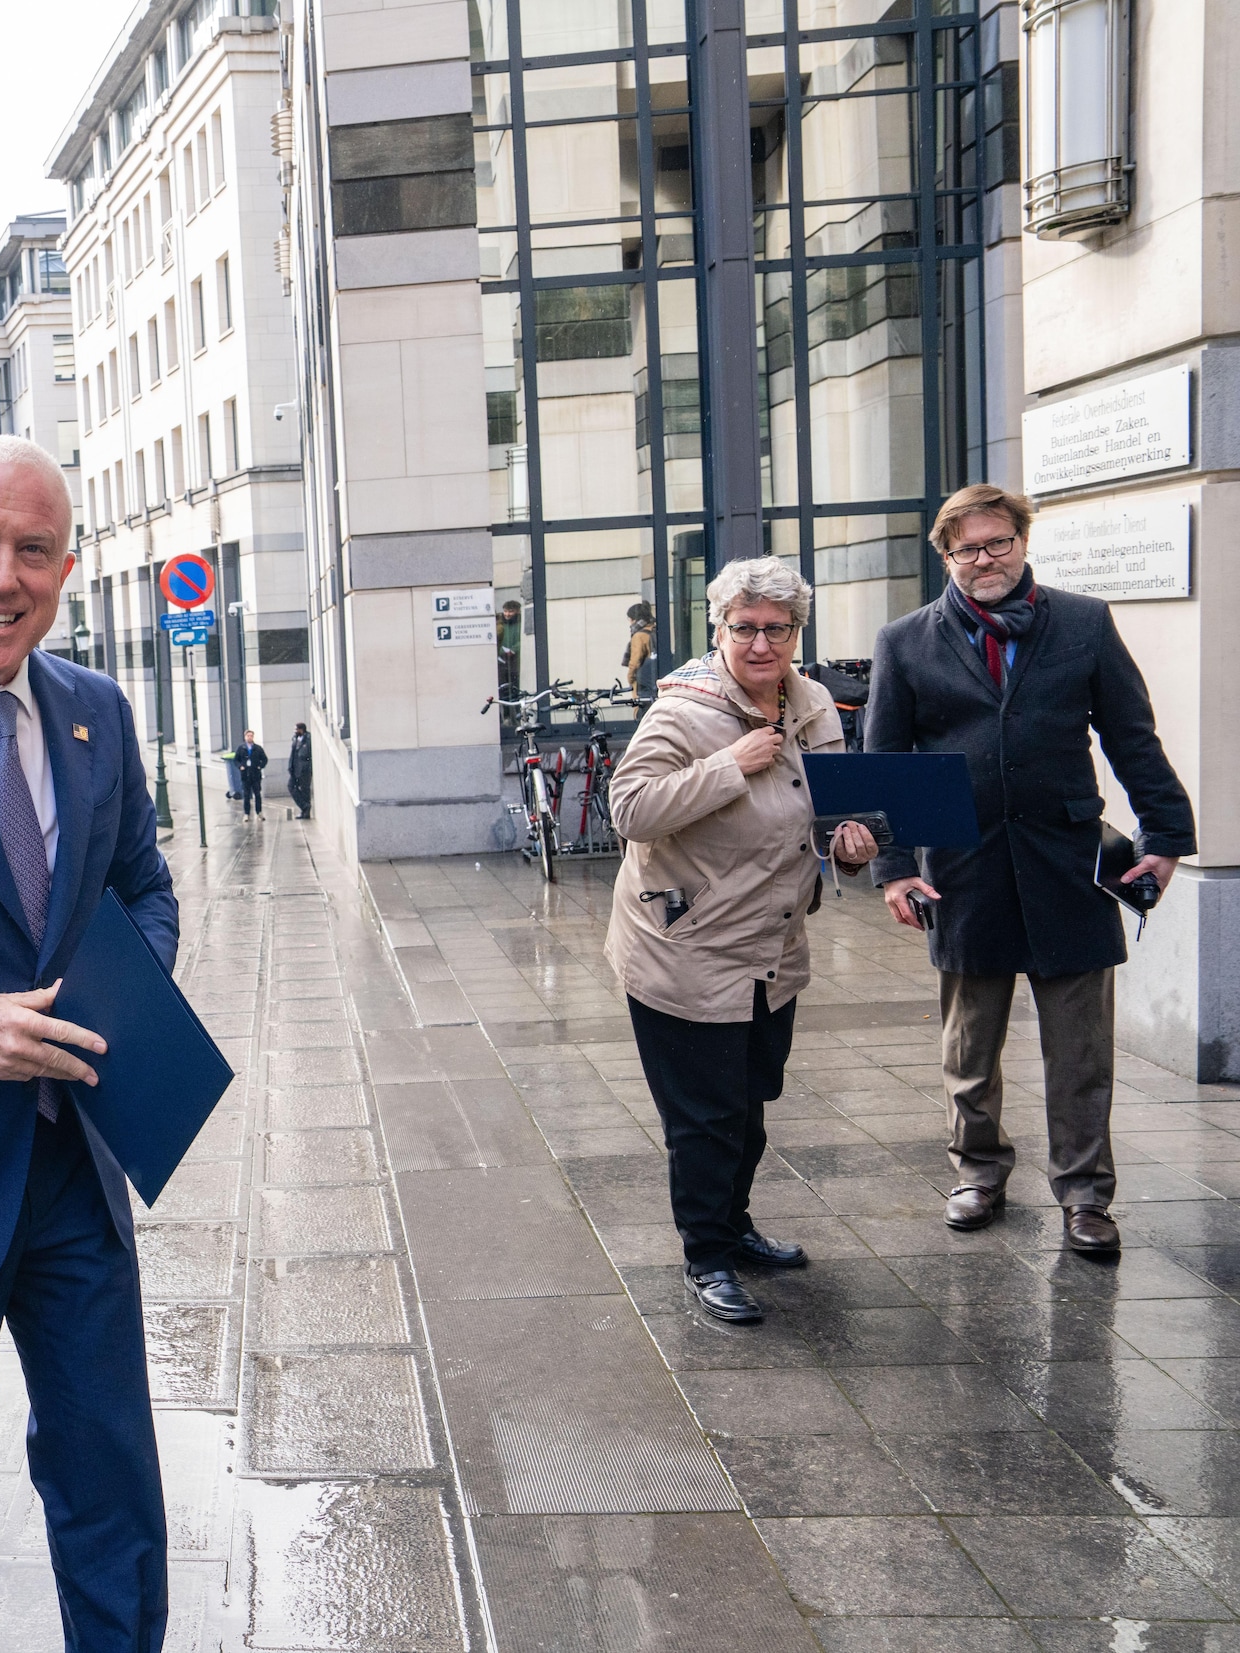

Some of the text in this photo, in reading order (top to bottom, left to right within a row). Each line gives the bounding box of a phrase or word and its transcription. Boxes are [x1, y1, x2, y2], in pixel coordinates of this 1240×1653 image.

[1084, 390, 1146, 420] Overheidsdienst
[1051, 425, 1110, 448] Buitenlandse
[1042, 431, 1161, 467] Buitenlandse Handel en
[1034, 447, 1171, 484] Ontwikkelingssamenwerking
[1124, 517, 1146, 533] Dienst
[1034, 549, 1082, 563] Auswärtige
[1054, 558, 1146, 578] Aussenhandel und
